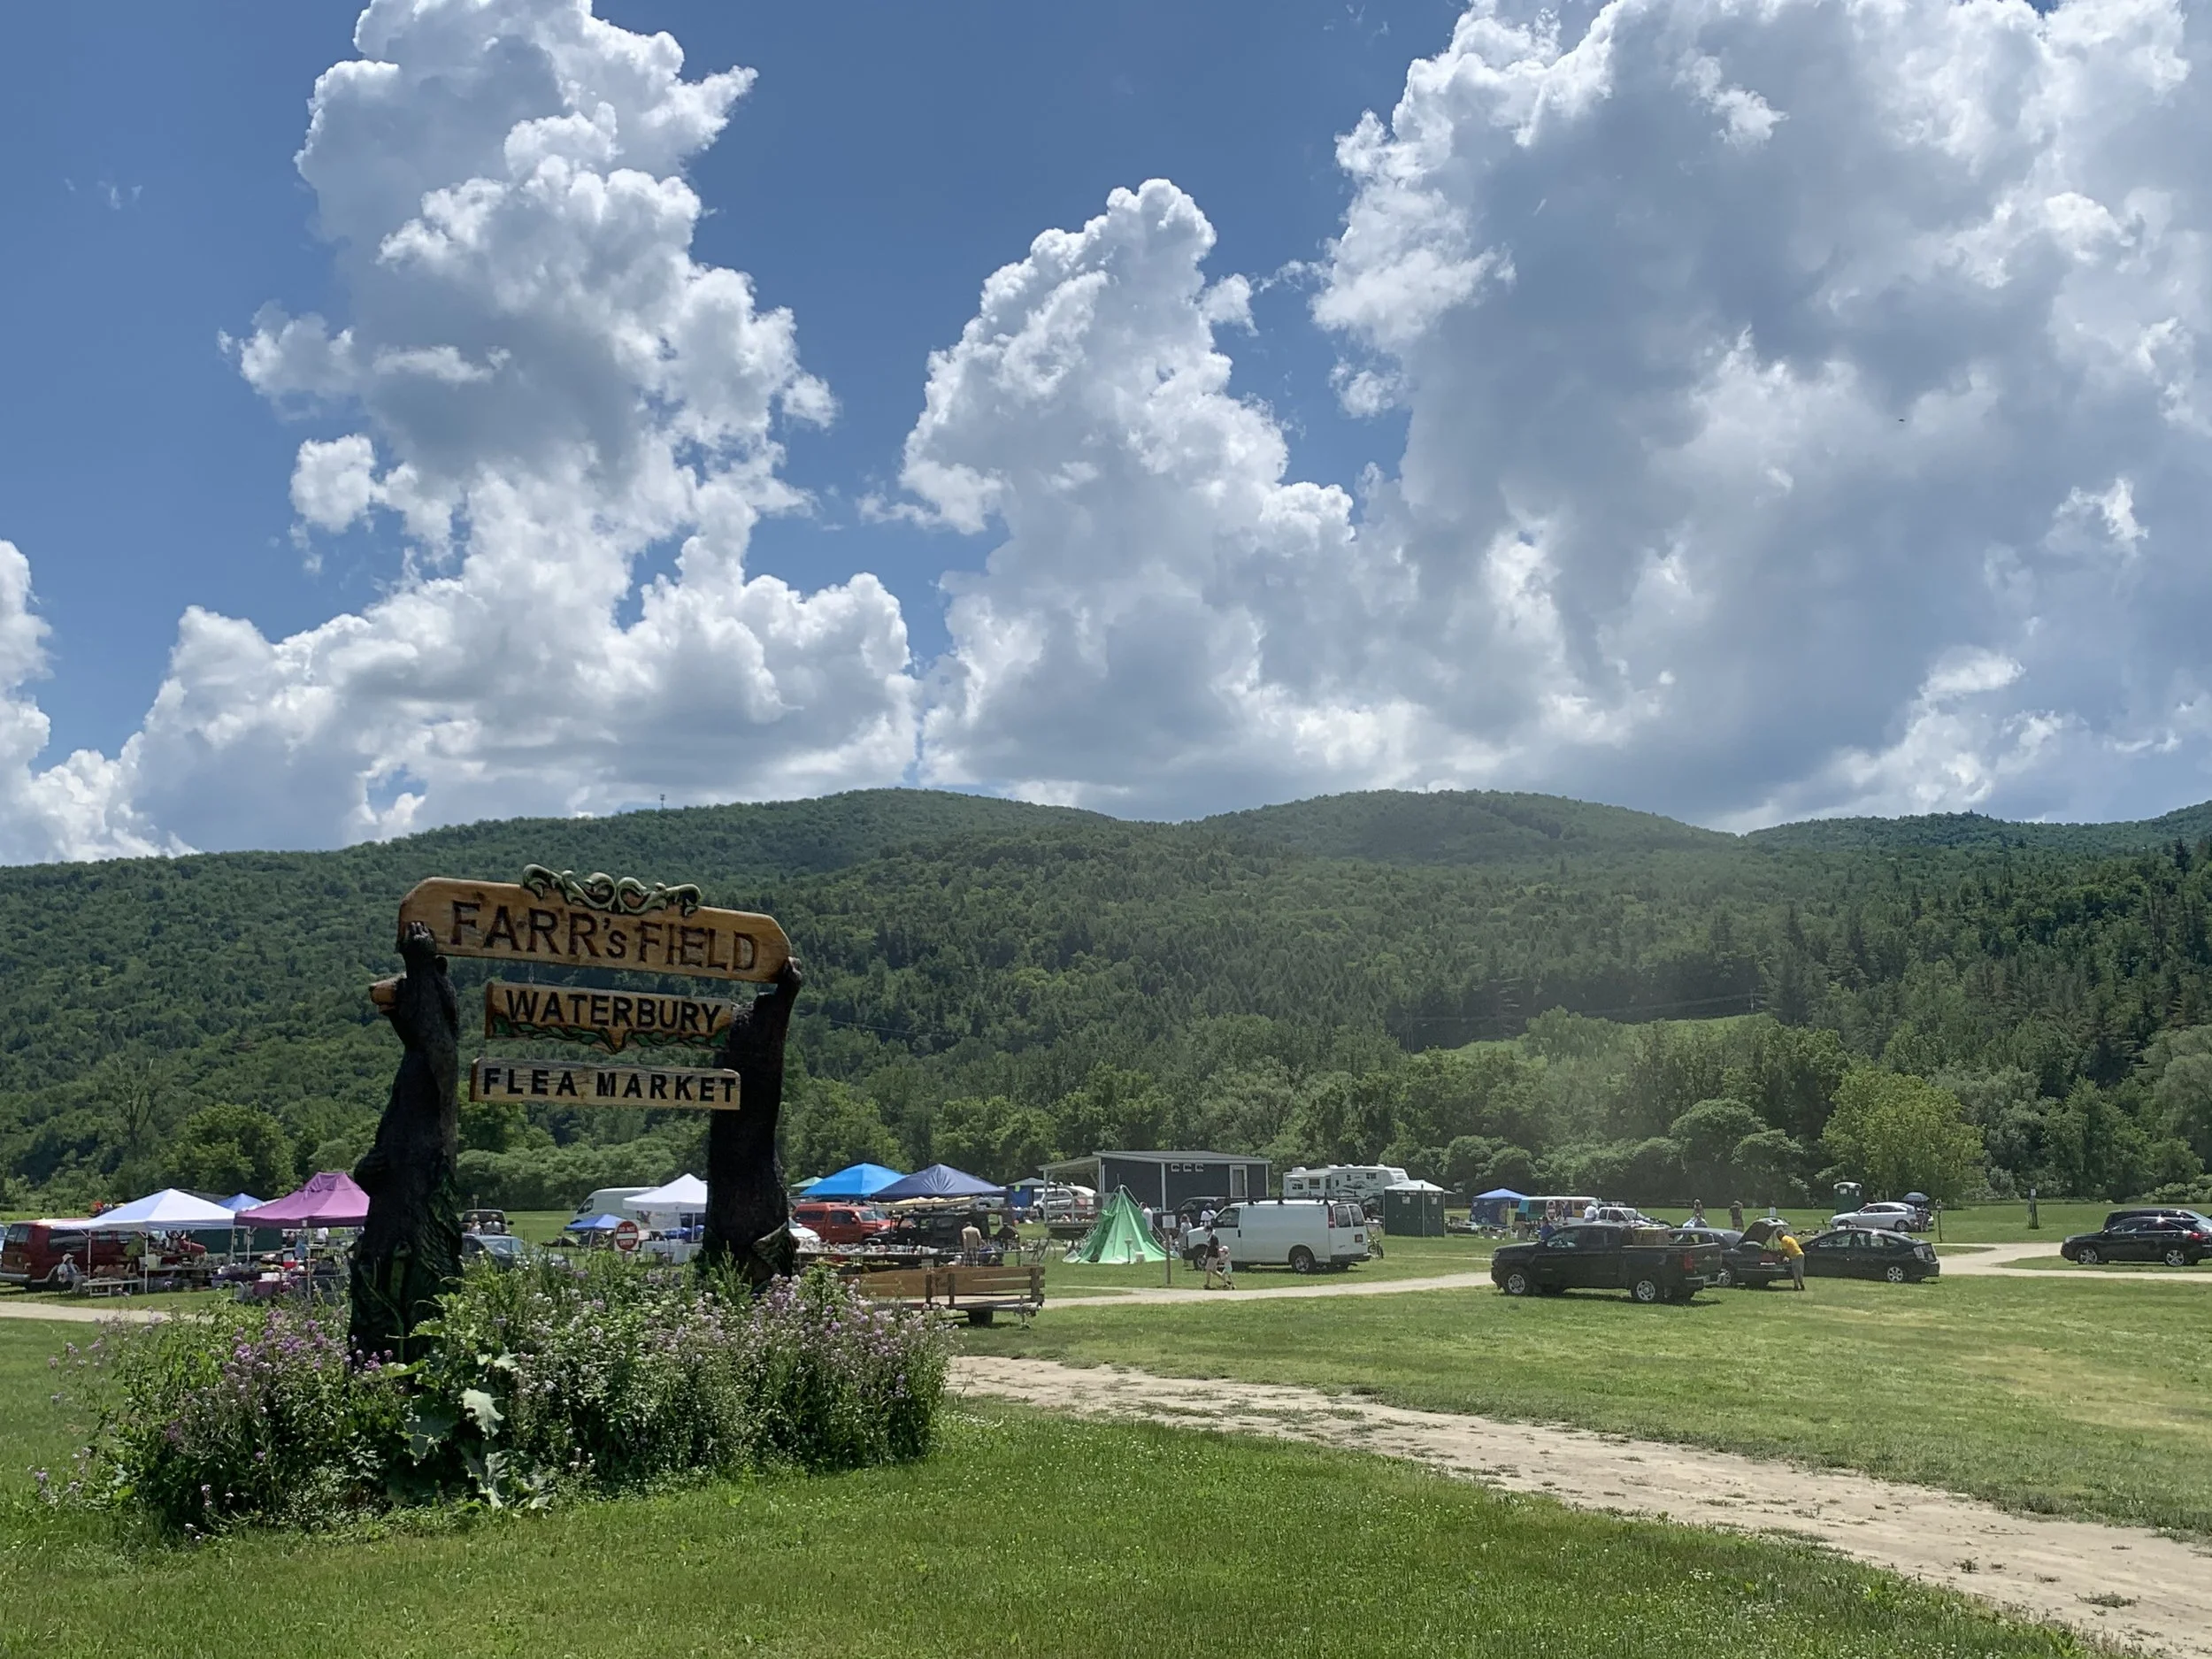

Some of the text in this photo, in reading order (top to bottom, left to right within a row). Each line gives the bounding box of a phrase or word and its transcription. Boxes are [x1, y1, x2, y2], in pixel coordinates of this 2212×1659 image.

[636, 920, 759, 971] FIELD
[506, 989, 720, 1032] WATERBURY
[483, 1068, 736, 1102] FLEA MARKET
